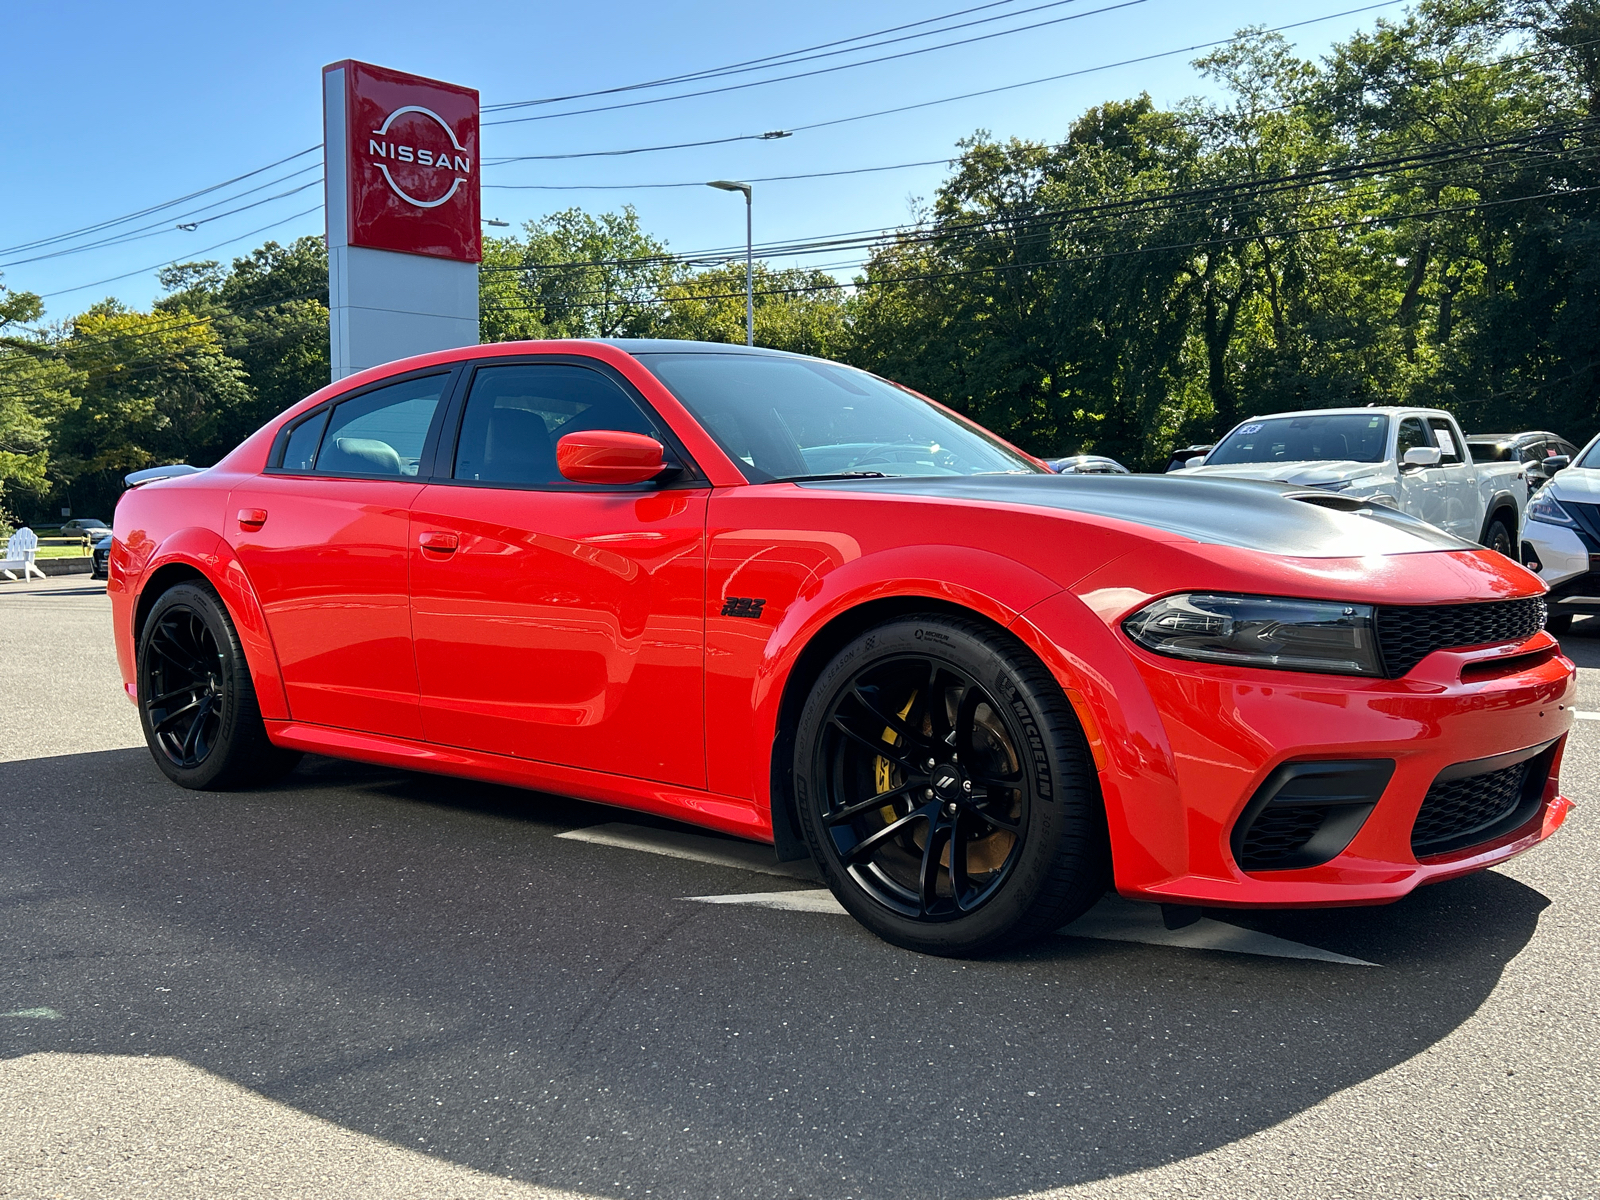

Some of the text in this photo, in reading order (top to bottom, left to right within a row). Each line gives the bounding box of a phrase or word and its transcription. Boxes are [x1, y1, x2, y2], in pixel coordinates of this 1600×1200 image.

[369, 139, 470, 173] NISSAN
[724, 597, 766, 609] 392
[925, 630, 950, 641] MICHELIN
[798, 736, 806, 765] PILOT
[802, 699, 817, 733] SPORT
[816, 684, 827, 700] ALL
[827, 650, 855, 681] SEASON
[1012, 700, 1051, 798] MICHELIN
[1031, 856, 1043, 873] ZR
